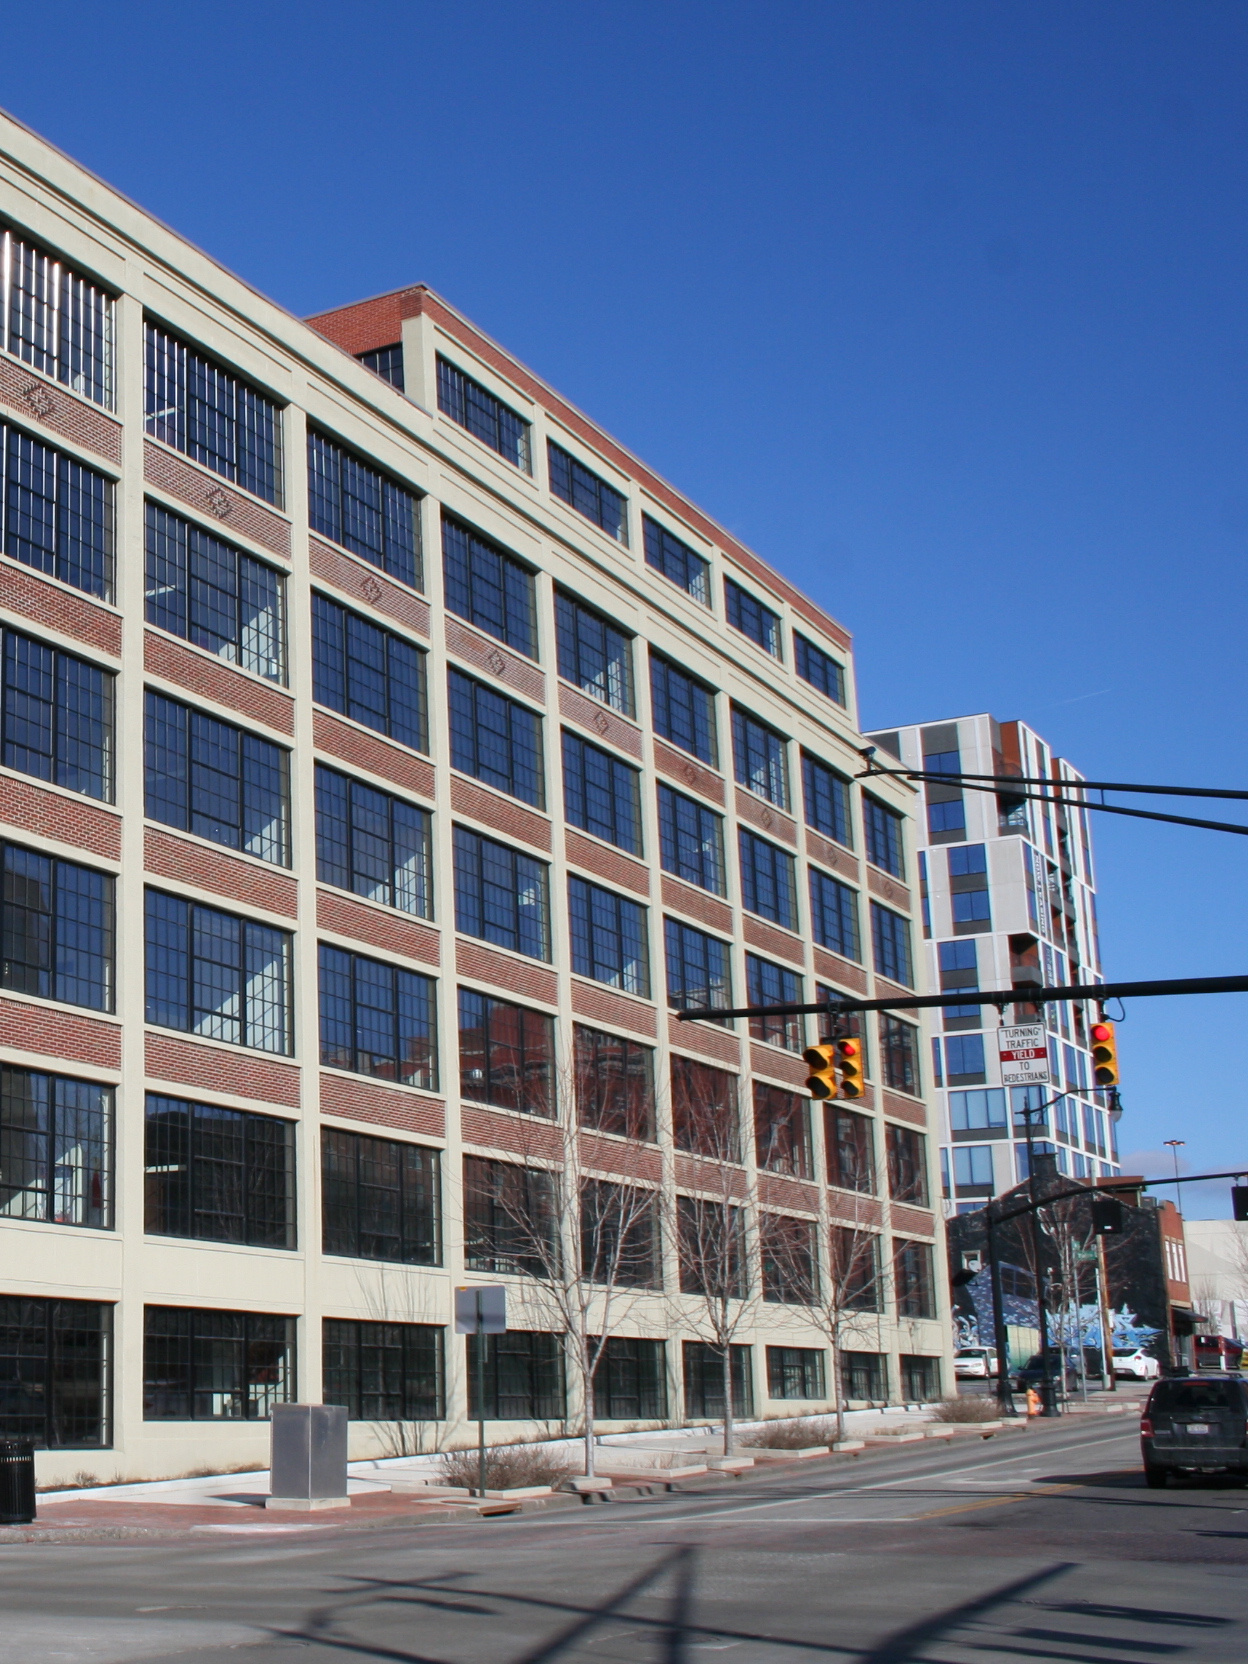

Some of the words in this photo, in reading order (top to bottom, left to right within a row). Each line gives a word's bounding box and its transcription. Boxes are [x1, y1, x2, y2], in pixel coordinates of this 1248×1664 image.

[1004, 1027, 1039, 1038] TURNING
[1006, 1038, 1039, 1049] TRAFFIC
[1011, 1049, 1035, 1060] YIELD
[1019, 1061, 1030, 1070] TO
[1004, 1071, 1048, 1083] PEDESTRIANS
